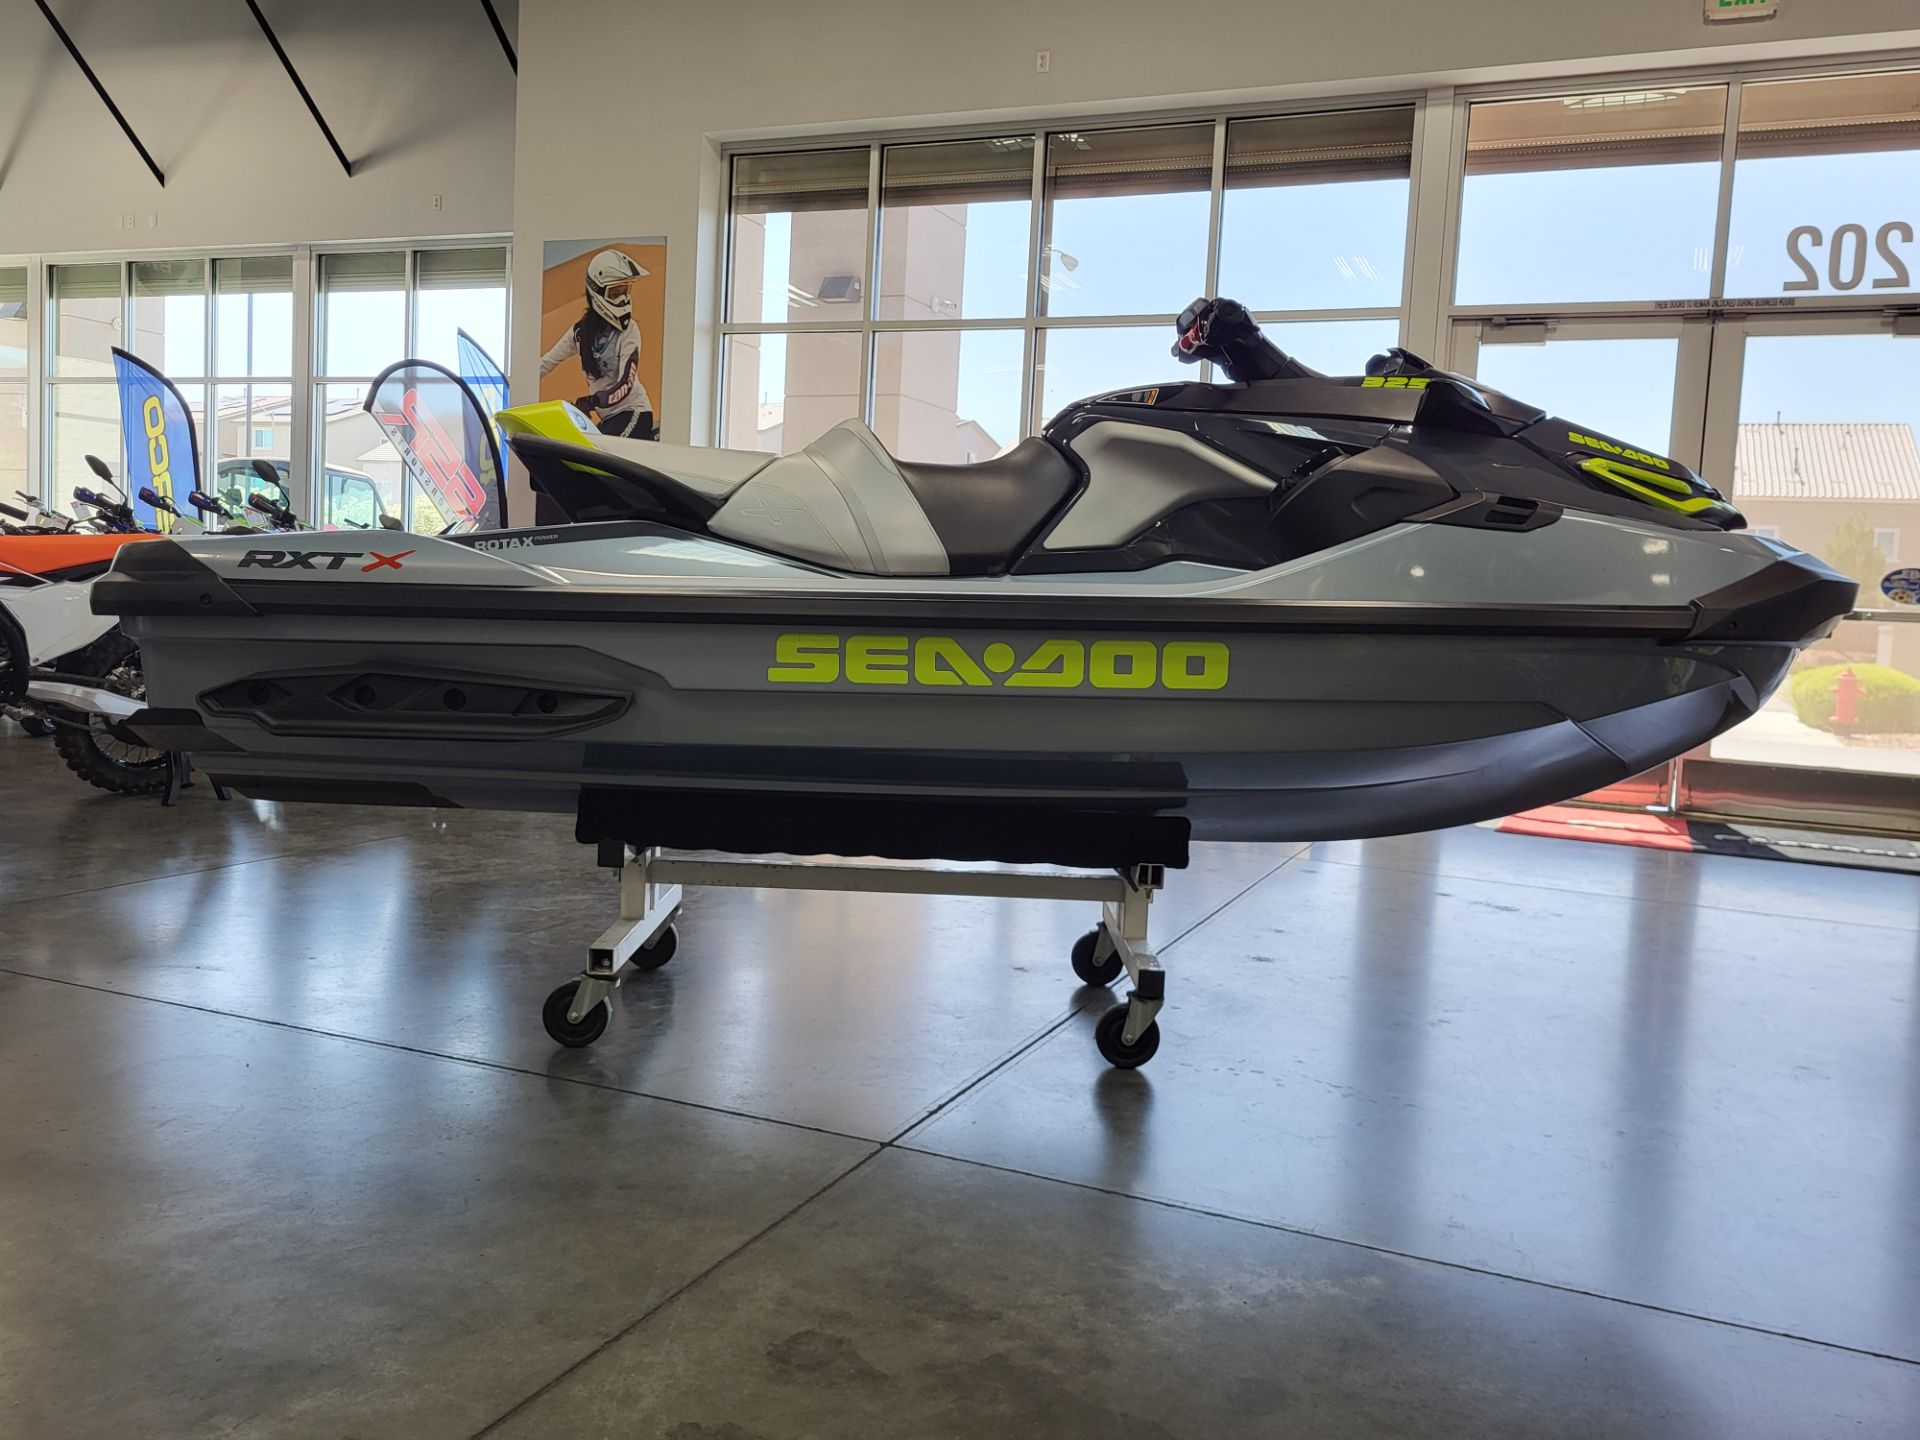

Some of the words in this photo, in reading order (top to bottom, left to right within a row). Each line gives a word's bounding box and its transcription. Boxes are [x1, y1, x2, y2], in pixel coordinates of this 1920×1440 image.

[1361, 376, 1433, 389] 325
[474, 536, 535, 551] ROTAX
[534, 534, 559, 542] POWER
[237, 549, 364, 570] RXT
[360, 549, 416, 573] X
